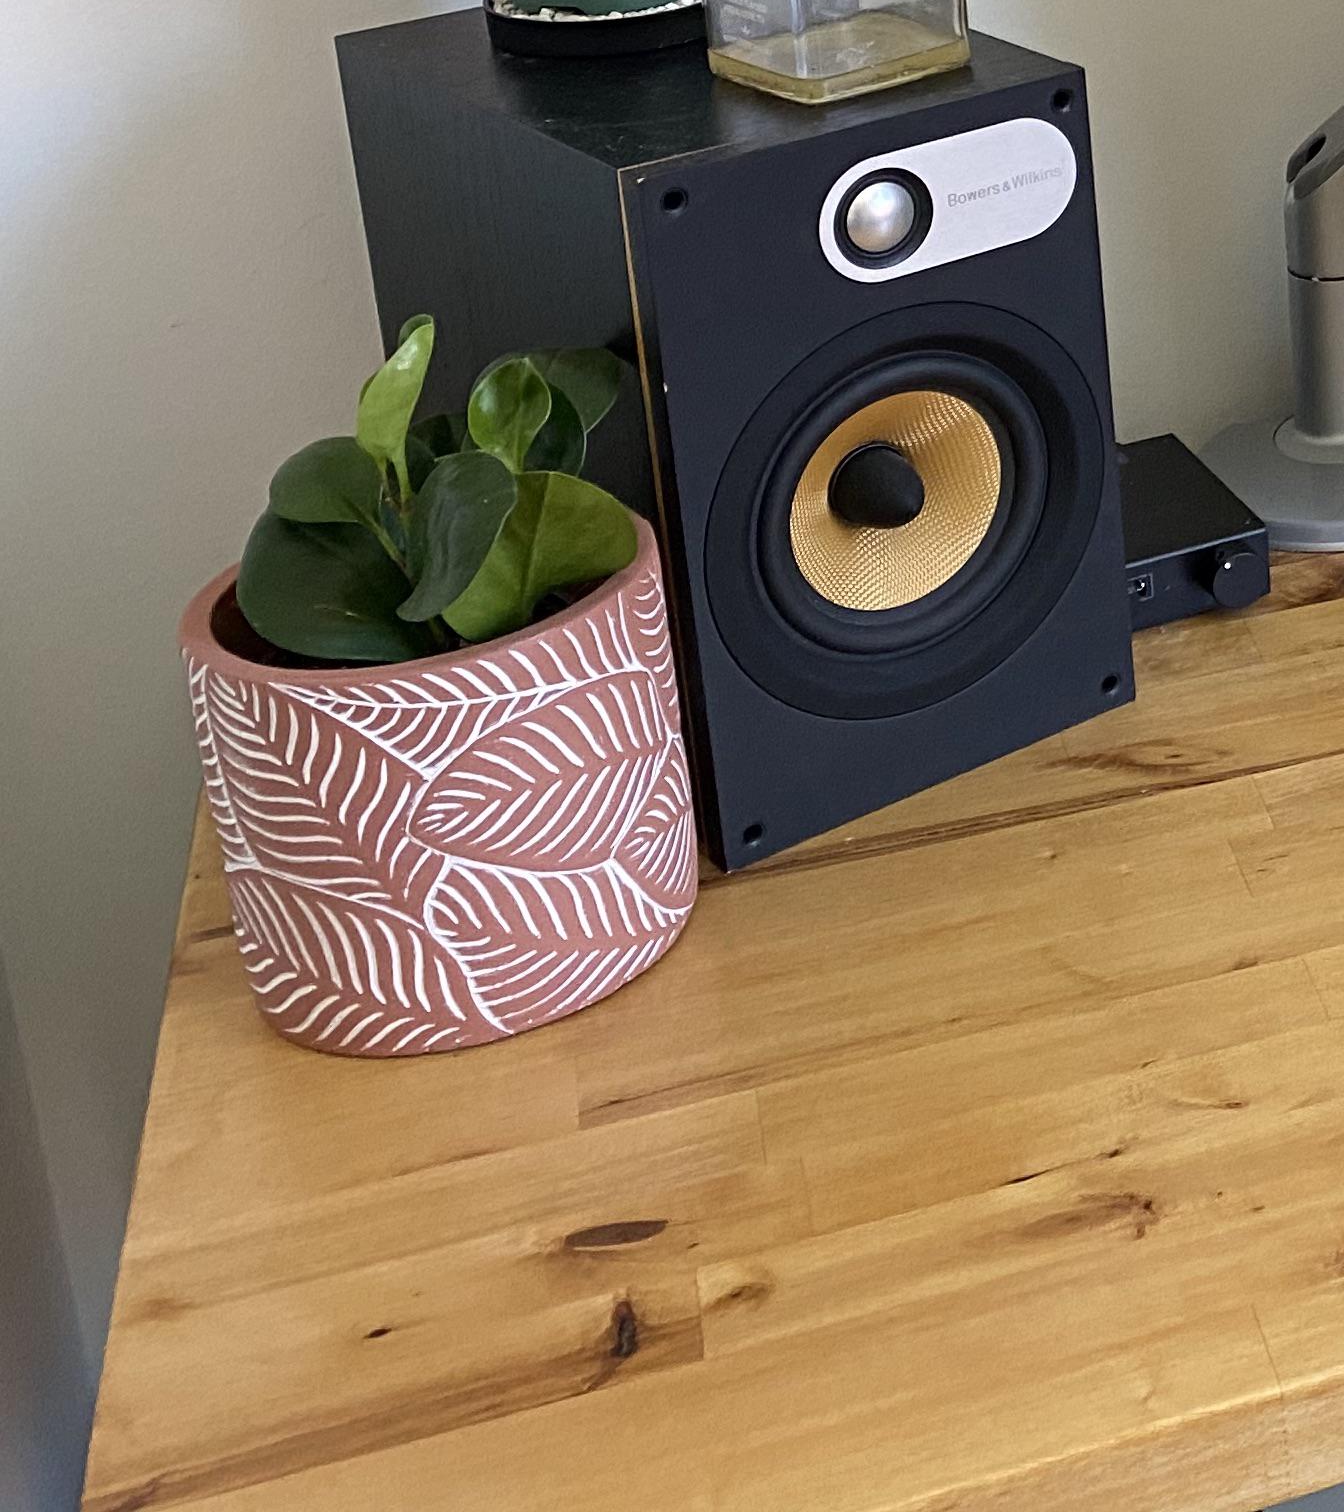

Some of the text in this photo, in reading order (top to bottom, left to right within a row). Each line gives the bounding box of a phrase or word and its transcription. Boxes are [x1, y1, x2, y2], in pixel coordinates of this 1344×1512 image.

[948, 167, 1063, 207] Bowers & Wilkins
